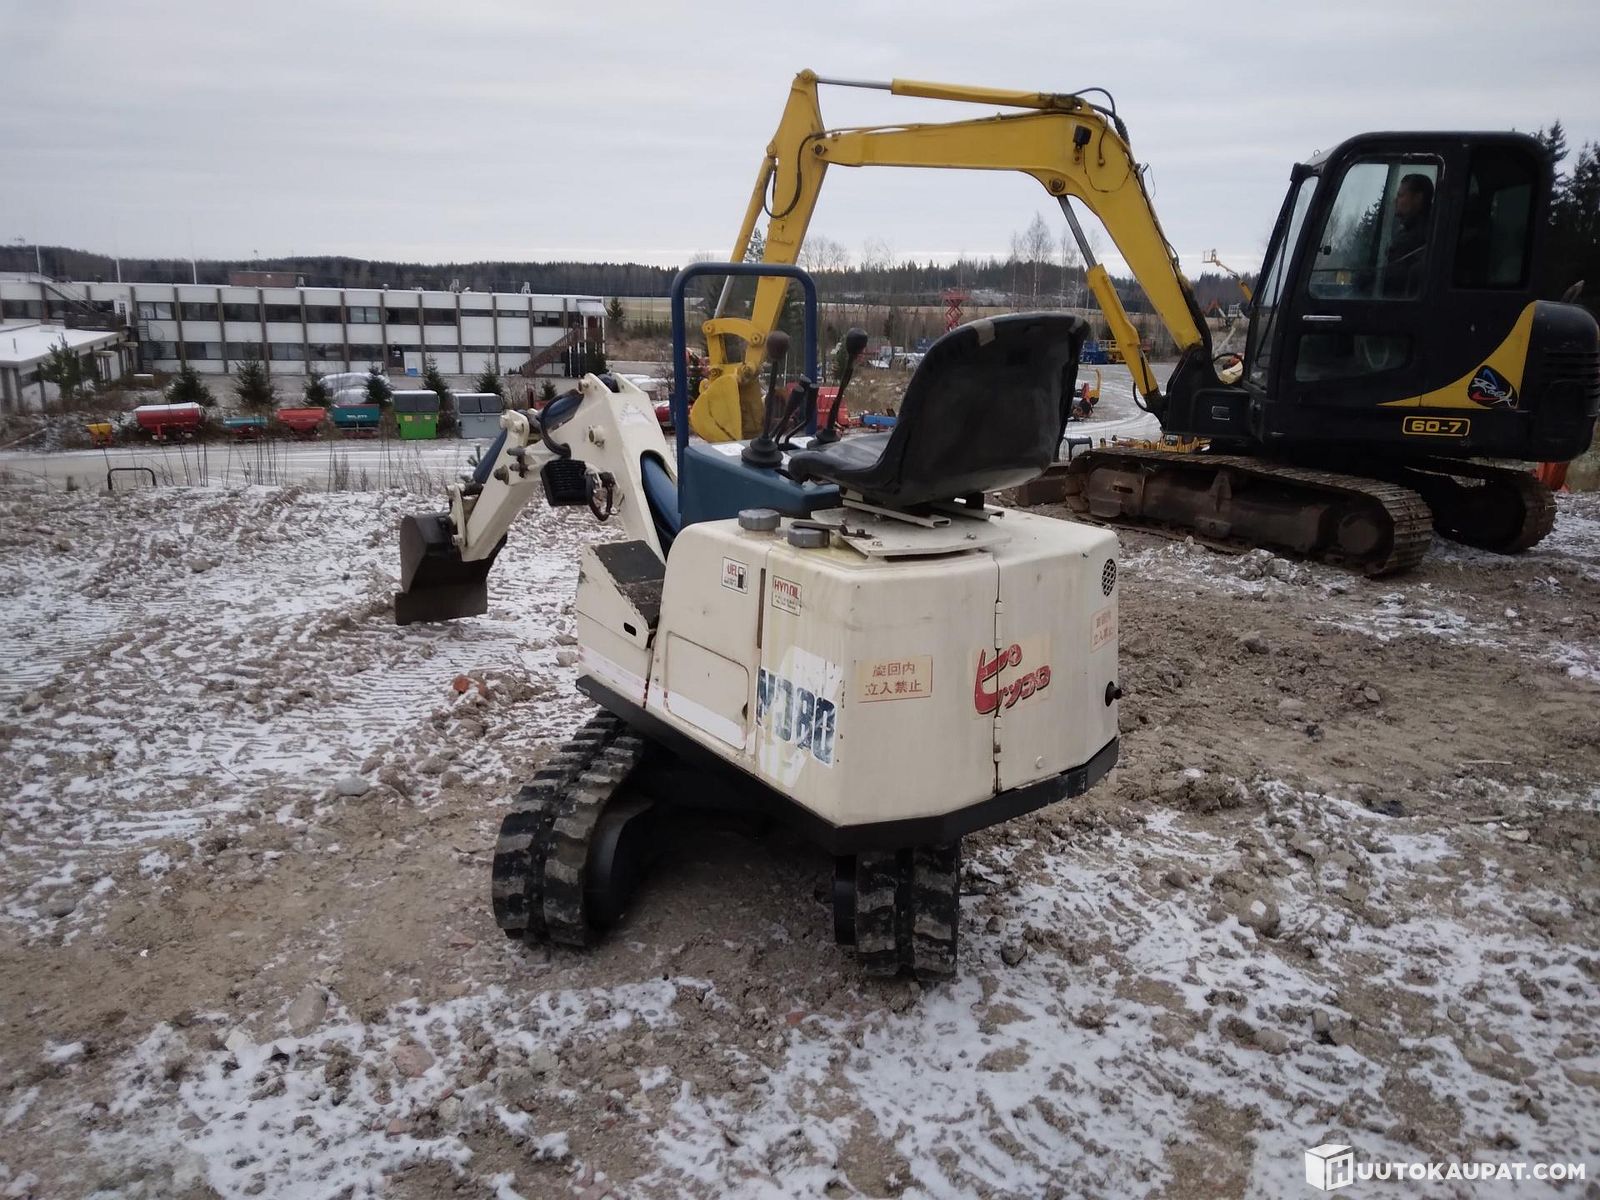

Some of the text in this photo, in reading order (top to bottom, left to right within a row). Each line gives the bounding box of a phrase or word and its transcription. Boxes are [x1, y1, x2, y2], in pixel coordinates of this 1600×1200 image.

[1411, 420, 1462, 433] 60-7
[872, 661, 916, 677] 旋回内
[864, 679, 923, 696] 立入禁止
